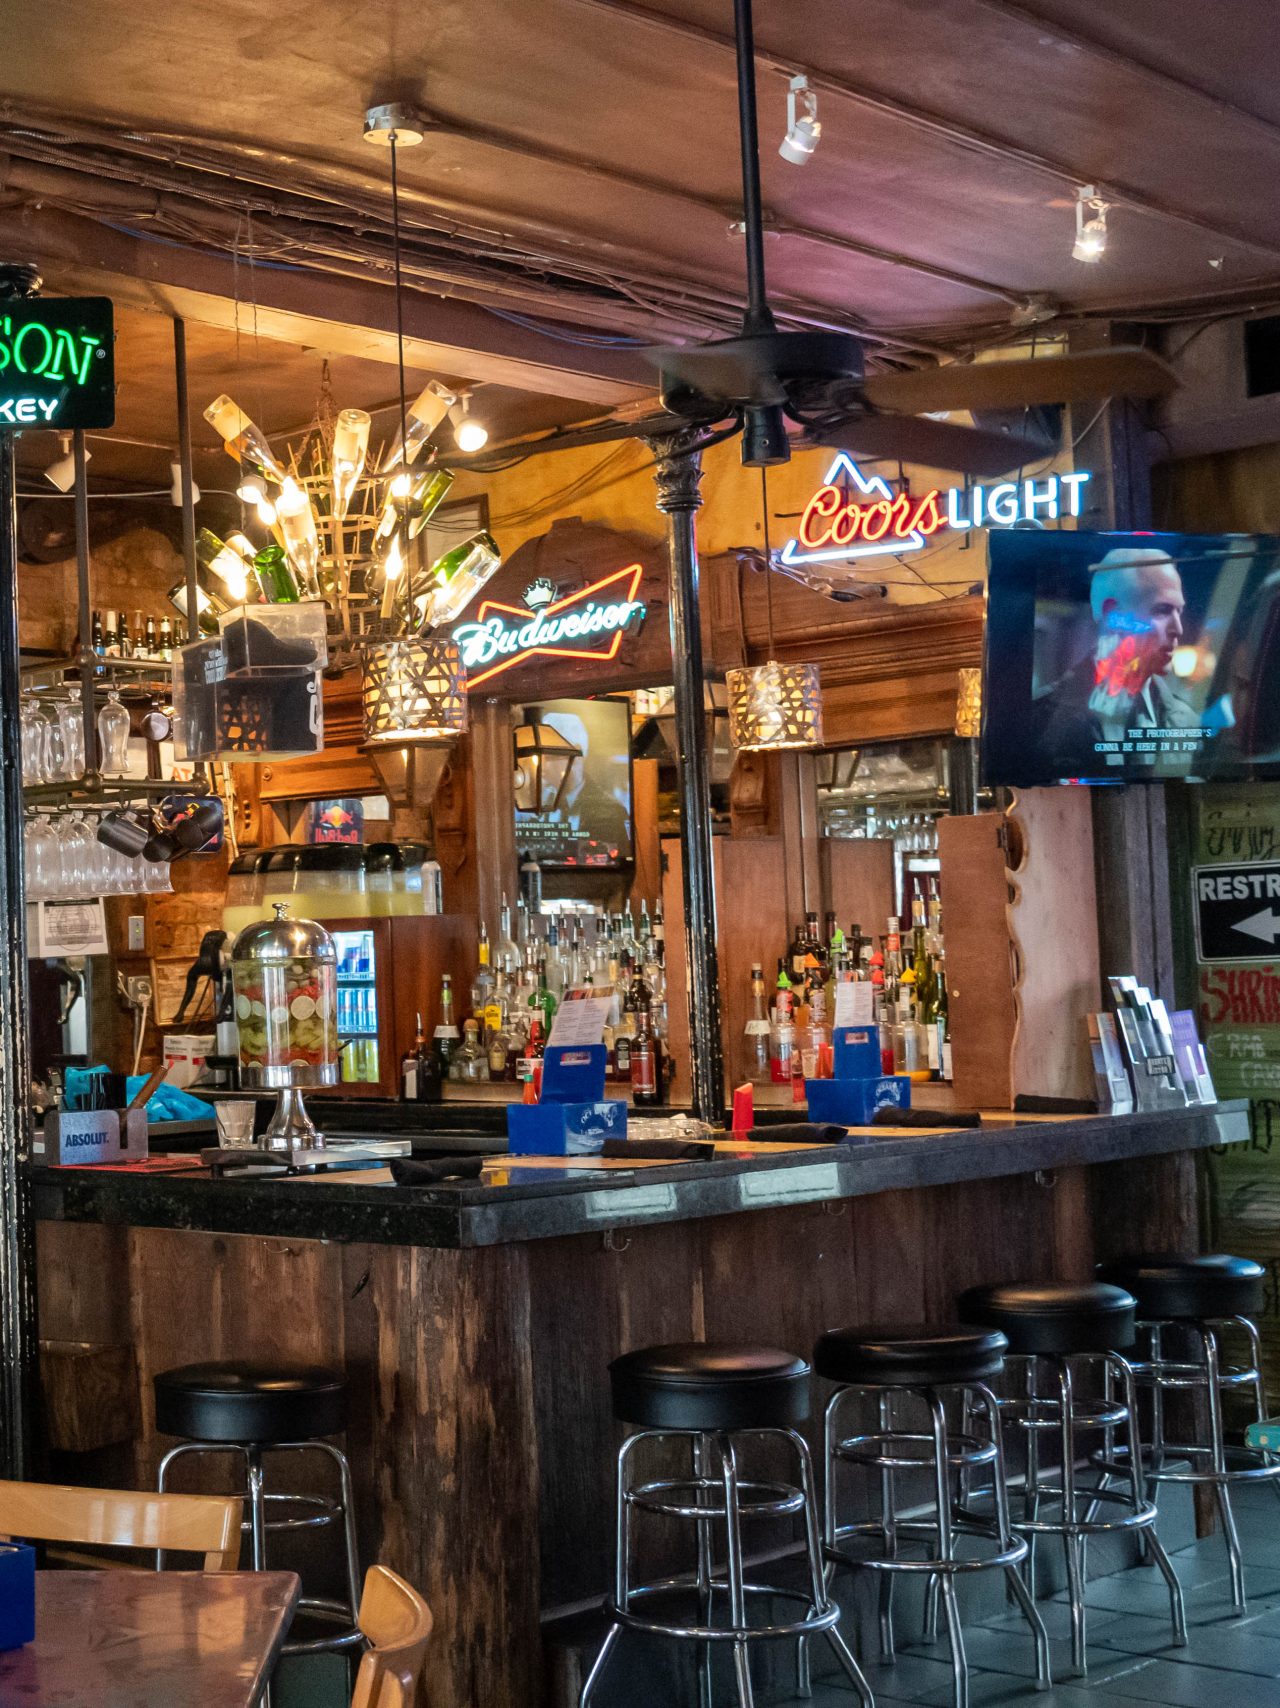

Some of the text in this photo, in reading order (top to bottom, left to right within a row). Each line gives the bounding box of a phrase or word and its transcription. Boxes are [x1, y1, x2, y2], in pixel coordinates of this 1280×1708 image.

[798, 472, 1091, 548] Coors LIGHT
[452, 601, 647, 666] Budweiser
[1094, 742, 1119, 752] GONNA
[1122, 742, 1133, 751] BE
[1136, 742, 1156, 751] HERE
[1160, 742, 1170, 751] IN
[1174, 742, 1179, 751] A
[1127, 728, 1143, 738] THE
